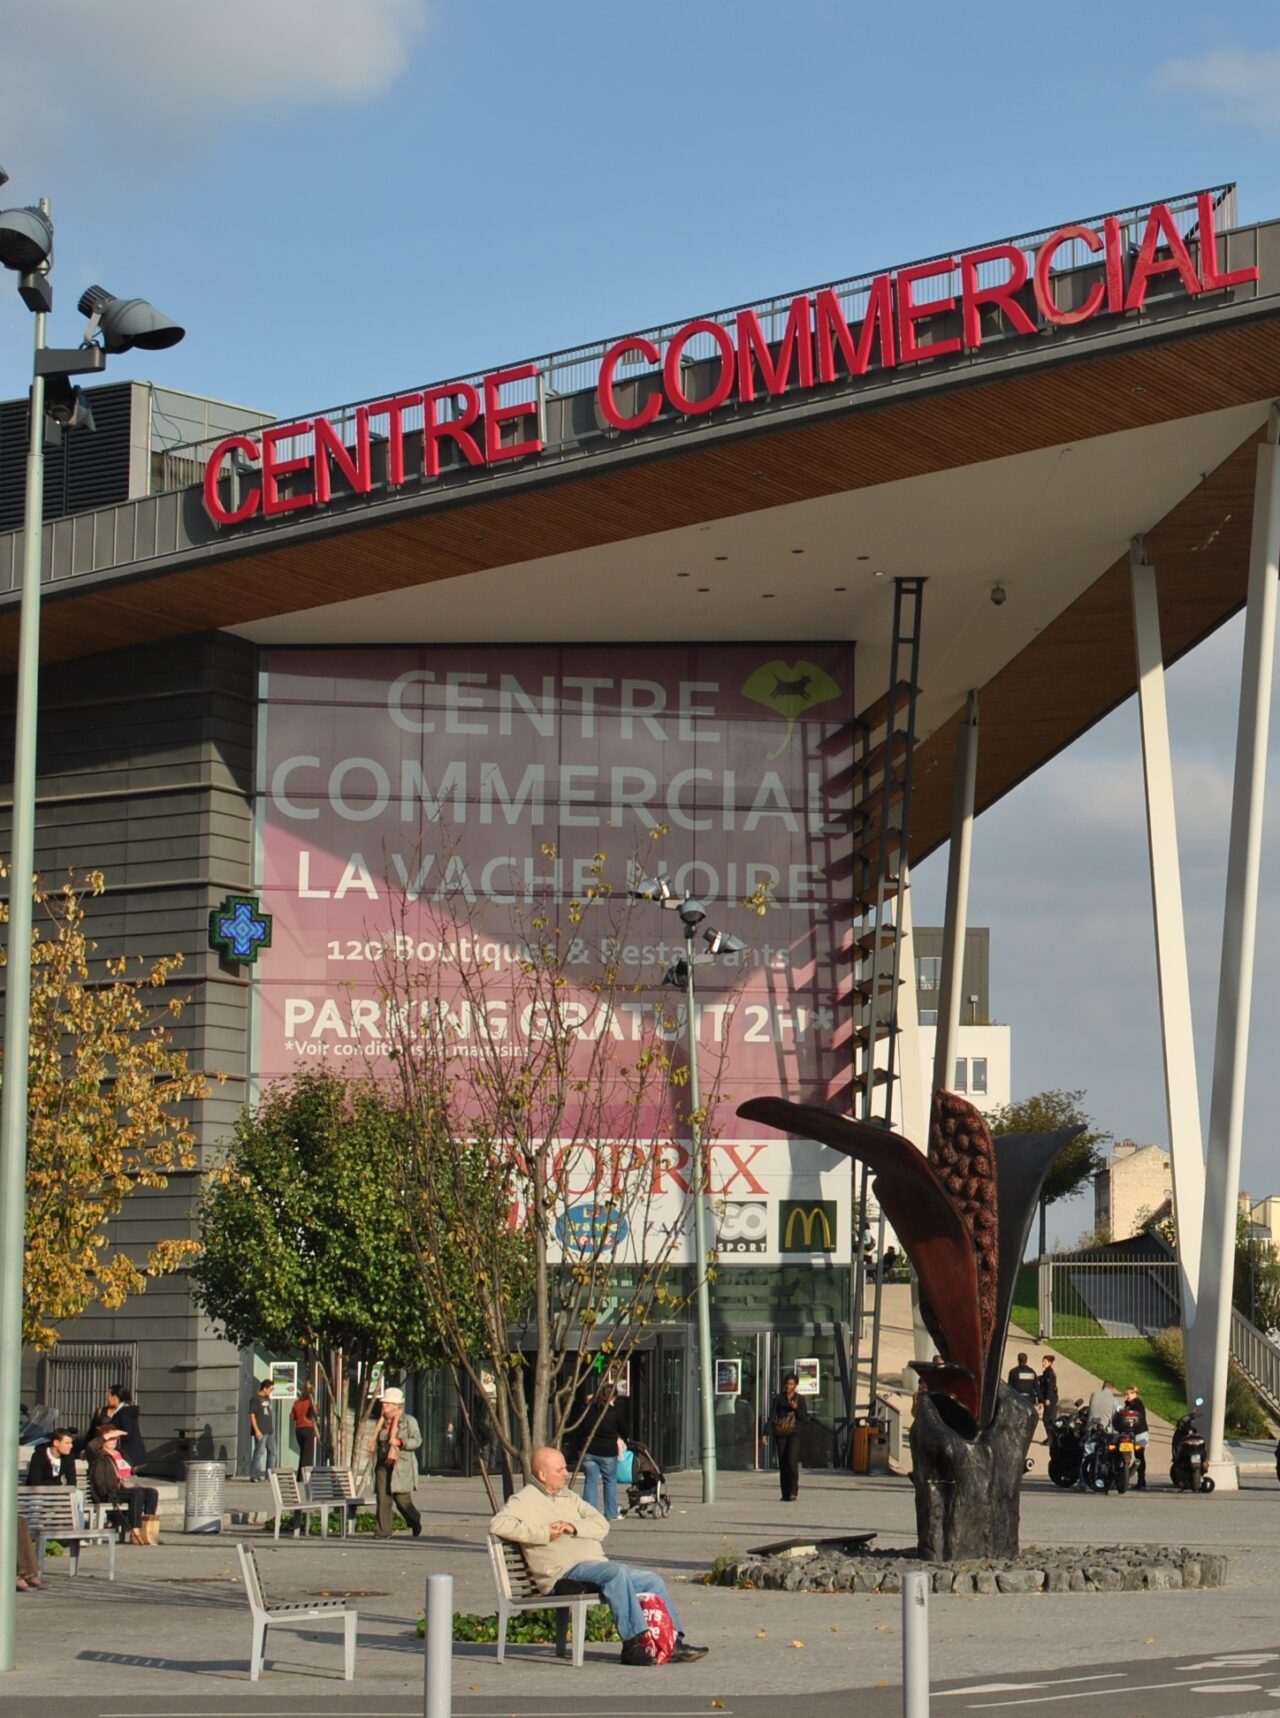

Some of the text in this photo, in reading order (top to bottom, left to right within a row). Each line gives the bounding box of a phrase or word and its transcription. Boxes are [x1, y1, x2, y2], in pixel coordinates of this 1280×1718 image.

[203, 190, 1260, 526] CENTRE COMMERCIAL
[387, 669, 721, 744] CENTRE
[270, 754, 848, 835] COMMERCIAL
[297, 851, 379, 900] LA
[391, 854, 604, 906] VACHE
[327, 939, 384, 961] 120
[601, 937, 791, 969] Restaants
[284, 998, 508, 1040] PARKING
[717, 1242, 767, 1252] SPORT
